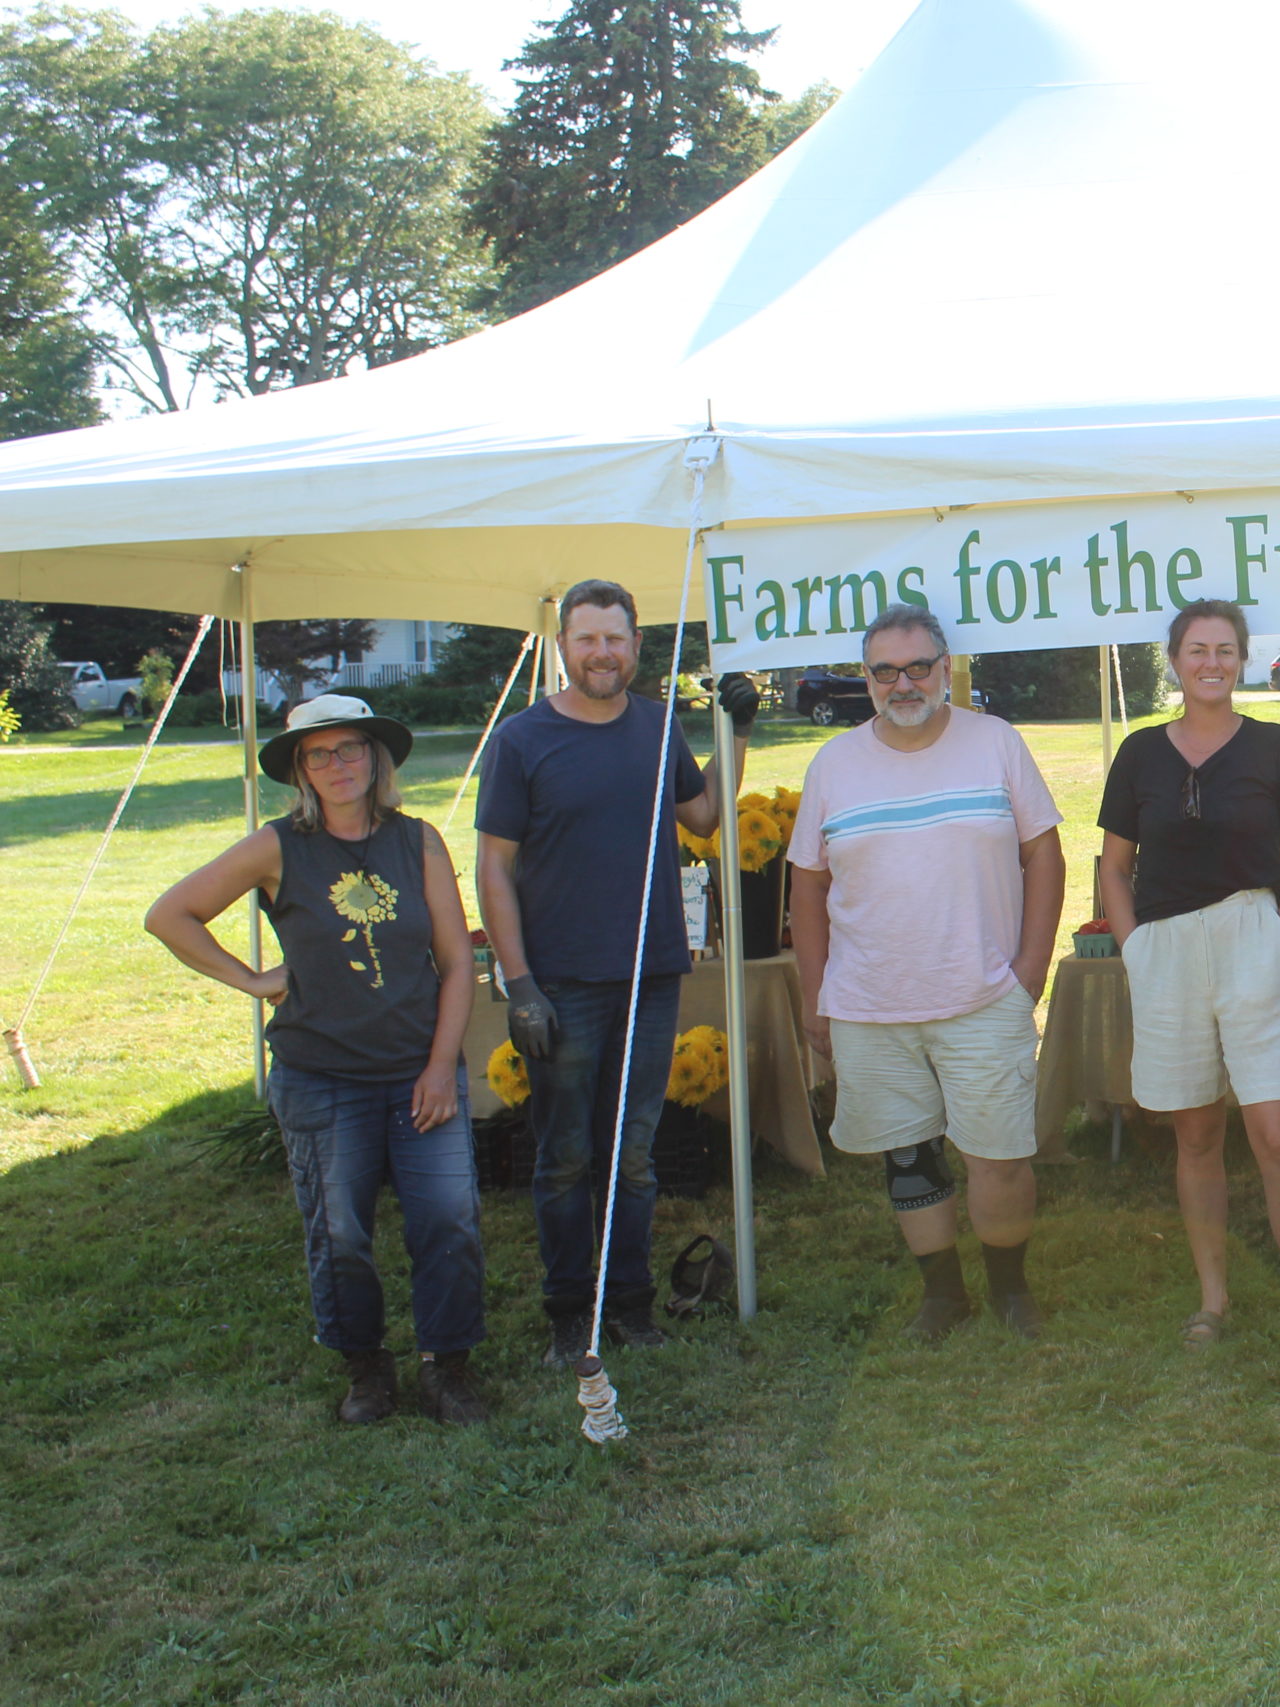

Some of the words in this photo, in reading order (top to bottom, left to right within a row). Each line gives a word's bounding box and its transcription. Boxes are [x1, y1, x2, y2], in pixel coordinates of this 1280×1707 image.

[708, 556, 928, 643] Farms
[954, 529, 1061, 625] for
[1083, 520, 1203, 616] the
